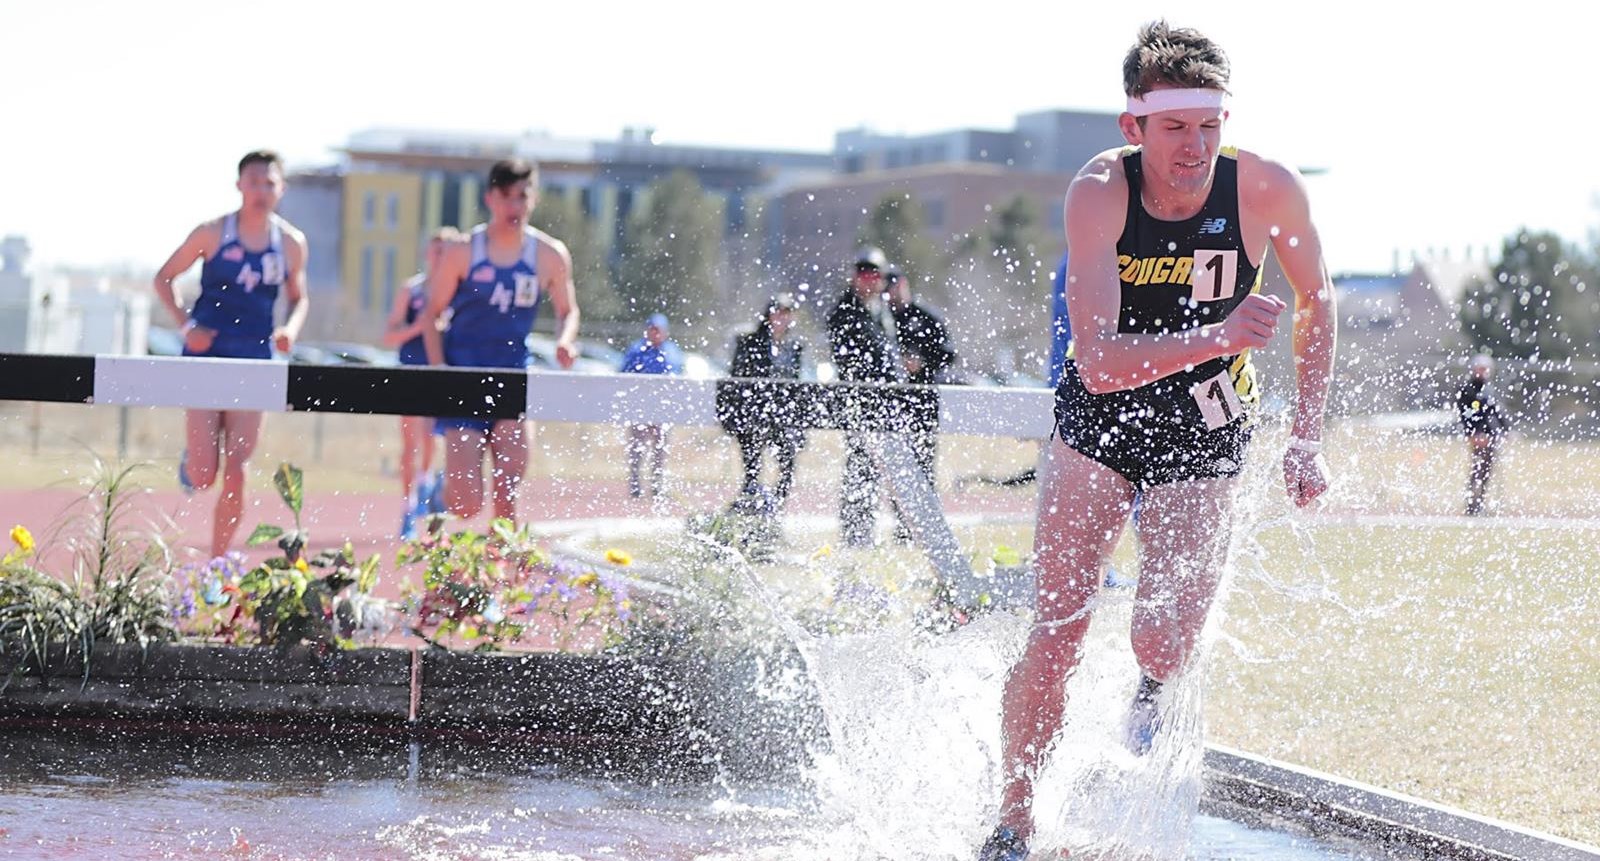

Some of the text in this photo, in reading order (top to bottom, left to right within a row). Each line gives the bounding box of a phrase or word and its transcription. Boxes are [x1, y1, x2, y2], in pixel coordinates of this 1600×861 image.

[1118, 255, 1194, 286] COUGA
[1205, 254, 1223, 298] 1
[1207, 380, 1233, 421] 1
